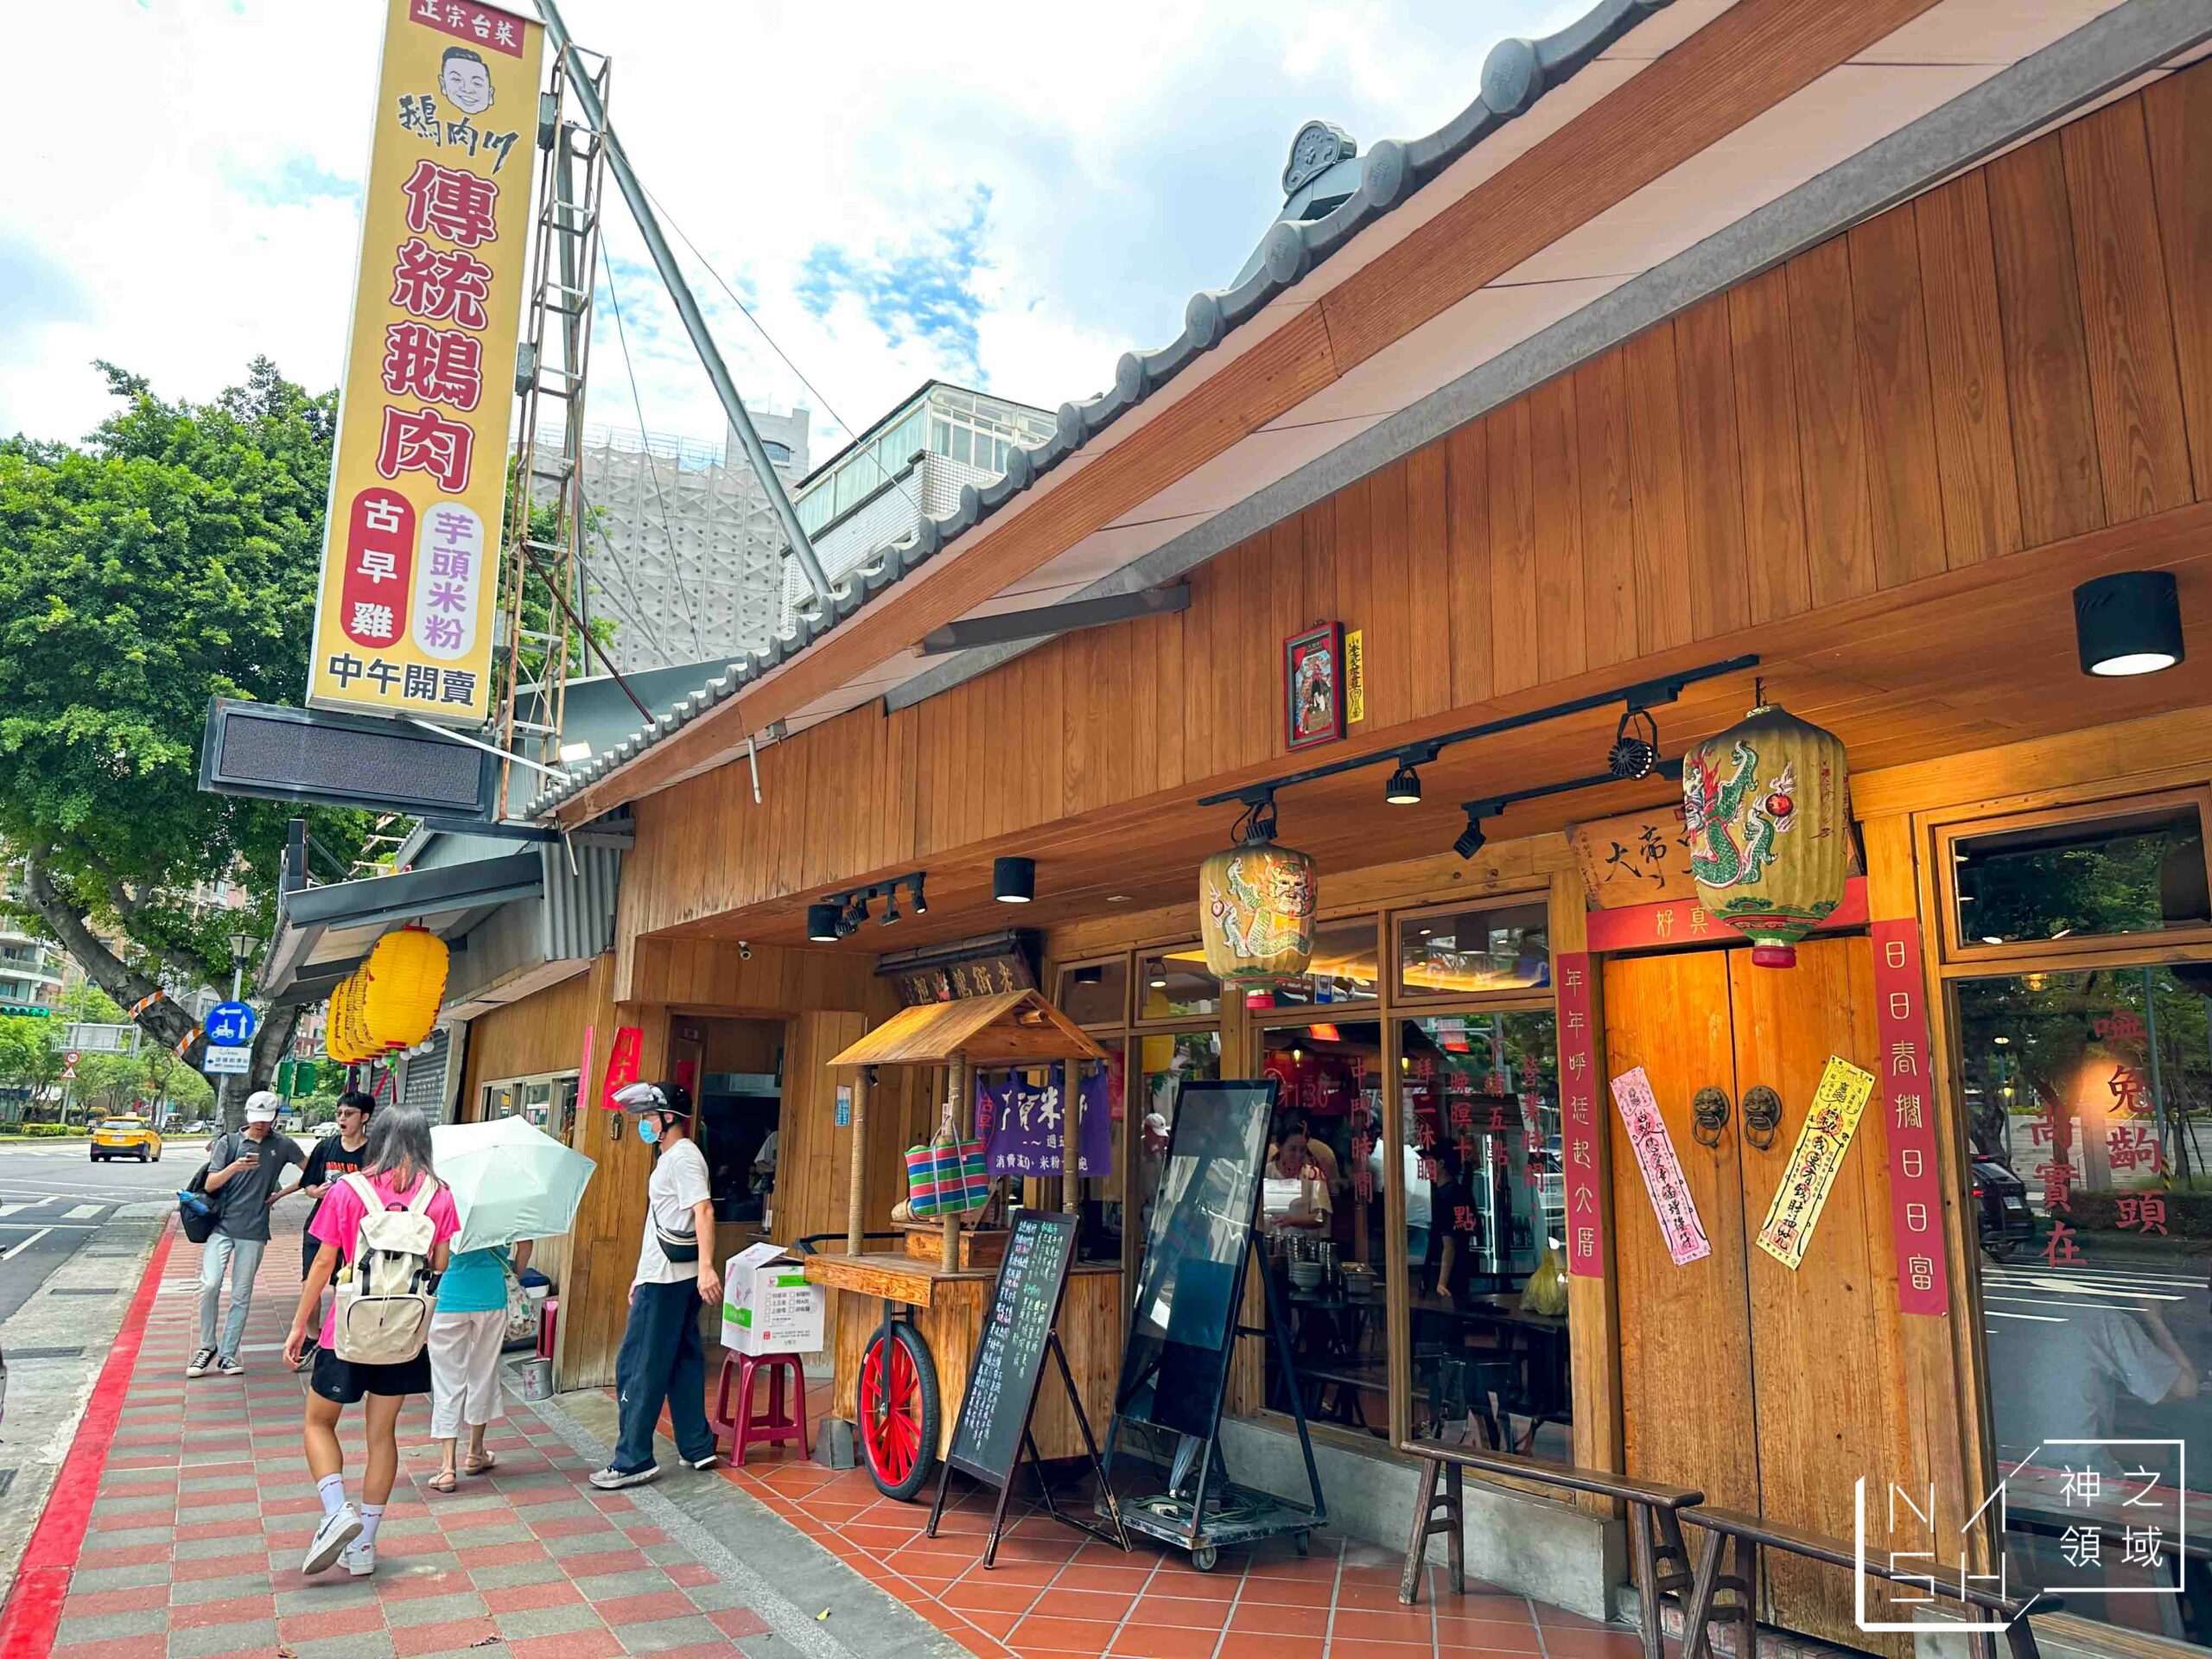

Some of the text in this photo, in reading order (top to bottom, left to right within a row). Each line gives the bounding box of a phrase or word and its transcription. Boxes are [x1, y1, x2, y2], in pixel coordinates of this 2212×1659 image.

[416, 0, 517, 48] 正宗台菜
[397, 93, 520, 175] 鵝肉川
[376, 159, 499, 494] 傳統鵝肉
[351, 498, 405, 639] 古早雞
[423, 511, 474, 651] 芋頭米粉
[327, 652, 476, 708] 中午開賣
